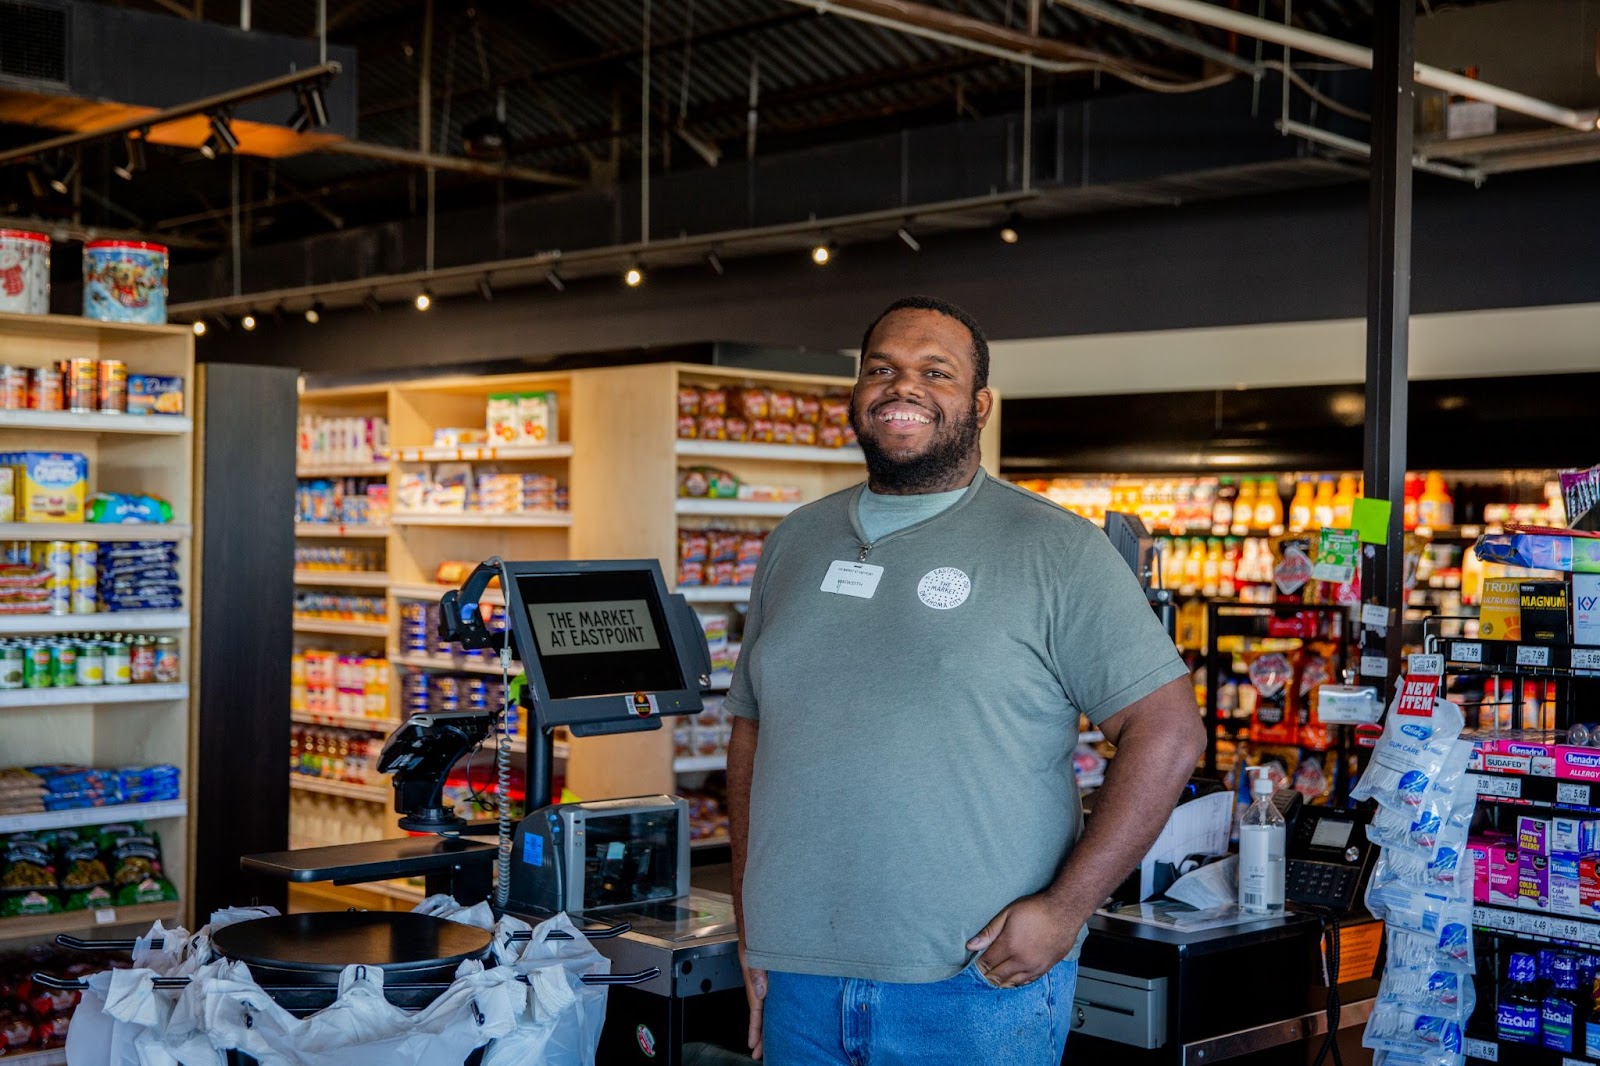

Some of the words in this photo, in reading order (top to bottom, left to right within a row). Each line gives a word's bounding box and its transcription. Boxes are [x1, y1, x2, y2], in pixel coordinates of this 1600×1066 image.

[933, 568, 966, 579] EASTPOINT
[930, 585, 956, 594] MARKET
[1484, 581, 1520, 593] TROJA
[949, 598, 962, 607] CITY
[1483, 596, 1503, 604] ULTRA
[1503, 597, 1520, 605] RIBB
[1520, 595, 1566, 608] MAGNUM
[547, 612, 576, 629] THE
[579, 609, 636, 627] MARKET
[551, 630, 566, 647] AT
[570, 626, 645, 646] EASTPOINT
[1466, 647, 1479, 657] 7.99
[1532, 650, 1545, 660] 7.99
[1426, 660, 1437, 669] 3.49
[1587, 654, 1600, 664] 5.69
[1405, 681, 1435, 695] NEW
[1400, 695, 1434, 711] ITEM
[1402, 725, 1425, 737] Glide
[1388, 740, 1402, 751] GUM
[1402, 744, 1420, 756] CARE
[1511, 746, 1545, 757] Benadryl
[1487, 759, 1522, 768] SUDAFED
[1569, 769, 1600, 778] ALLERGY
[1552, 887, 1564, 895] Cold
[1564, 925, 1578, 936] 6.99
[1497, 1013, 1536, 1028] ZzzQuil
[1542, 1009, 1572, 1024] ZzzQuil
[1482, 1046, 1495, 1056] 8.99
